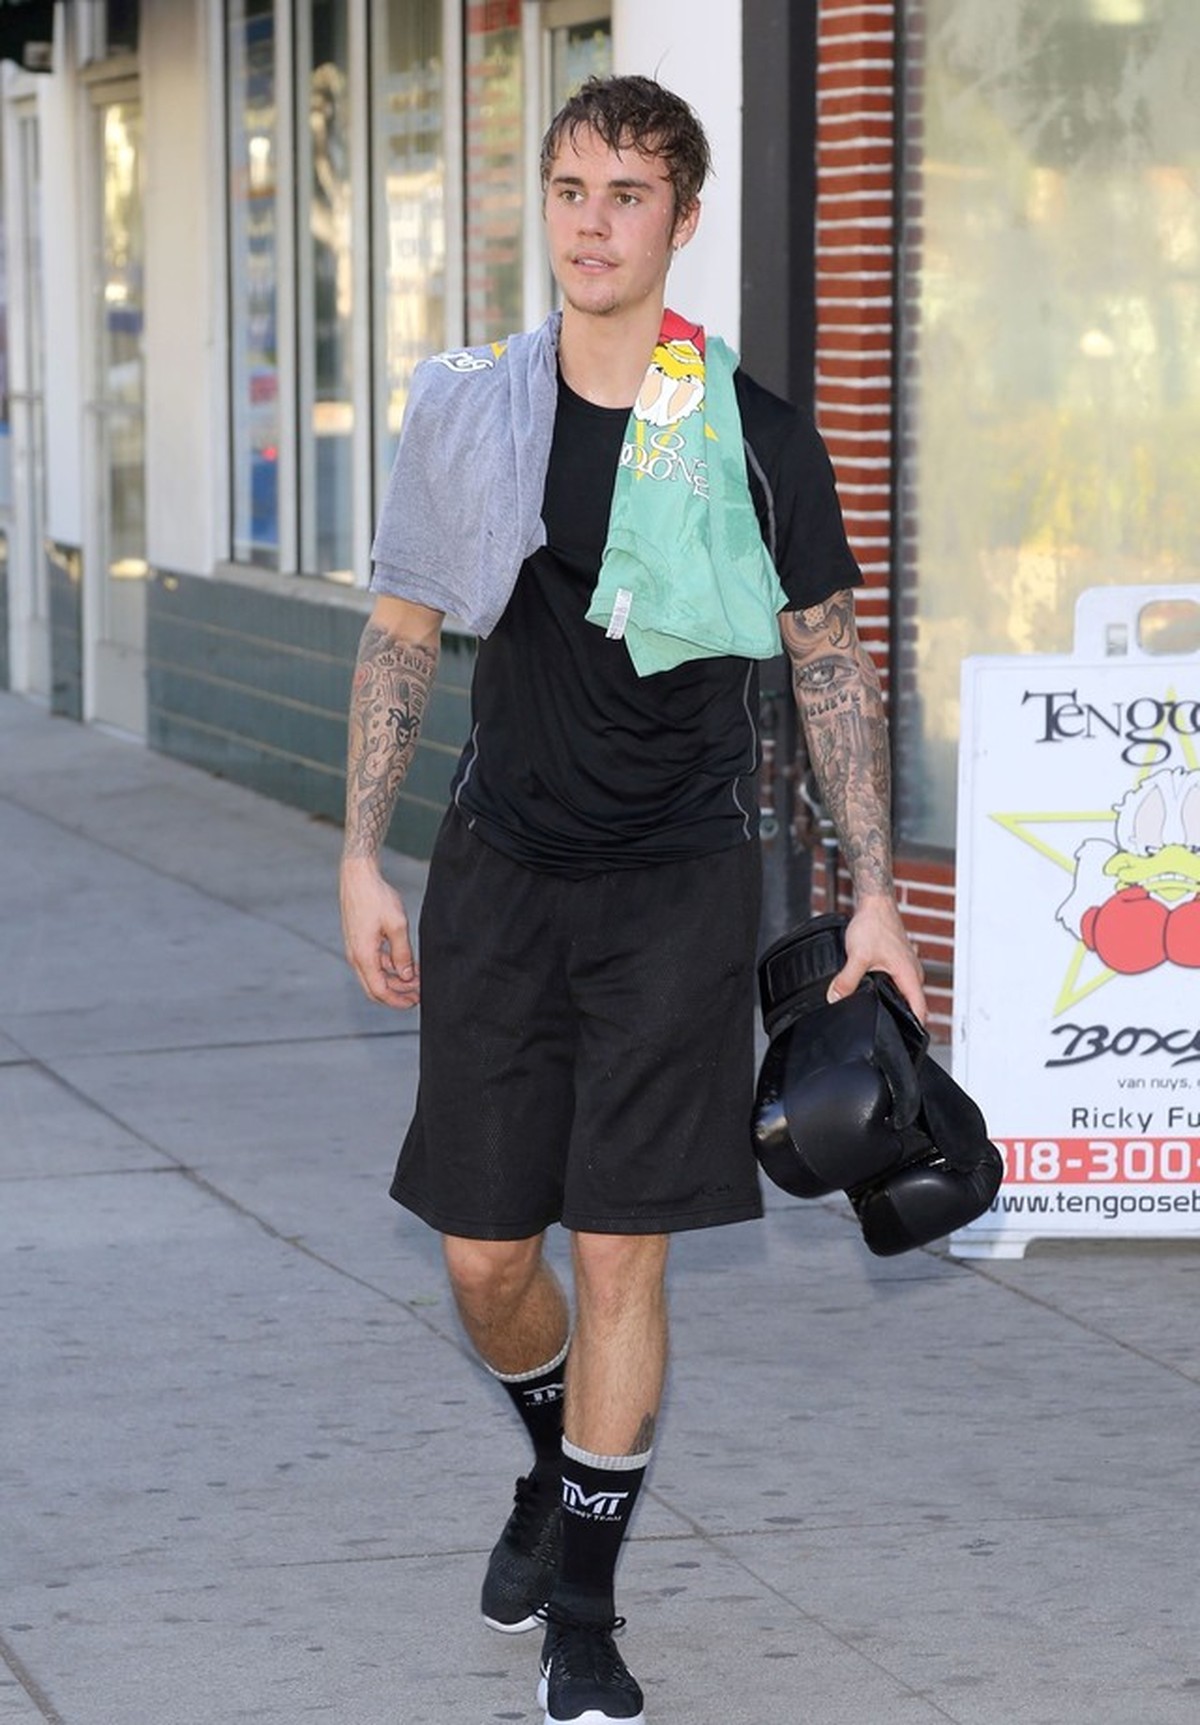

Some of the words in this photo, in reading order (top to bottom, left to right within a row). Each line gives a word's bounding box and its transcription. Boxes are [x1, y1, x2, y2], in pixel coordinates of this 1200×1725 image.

[1117, 1078, 1146, 1089] van
[1150, 1078, 1192, 1091] nuys,
[1071, 1107, 1153, 1134] Ricky
